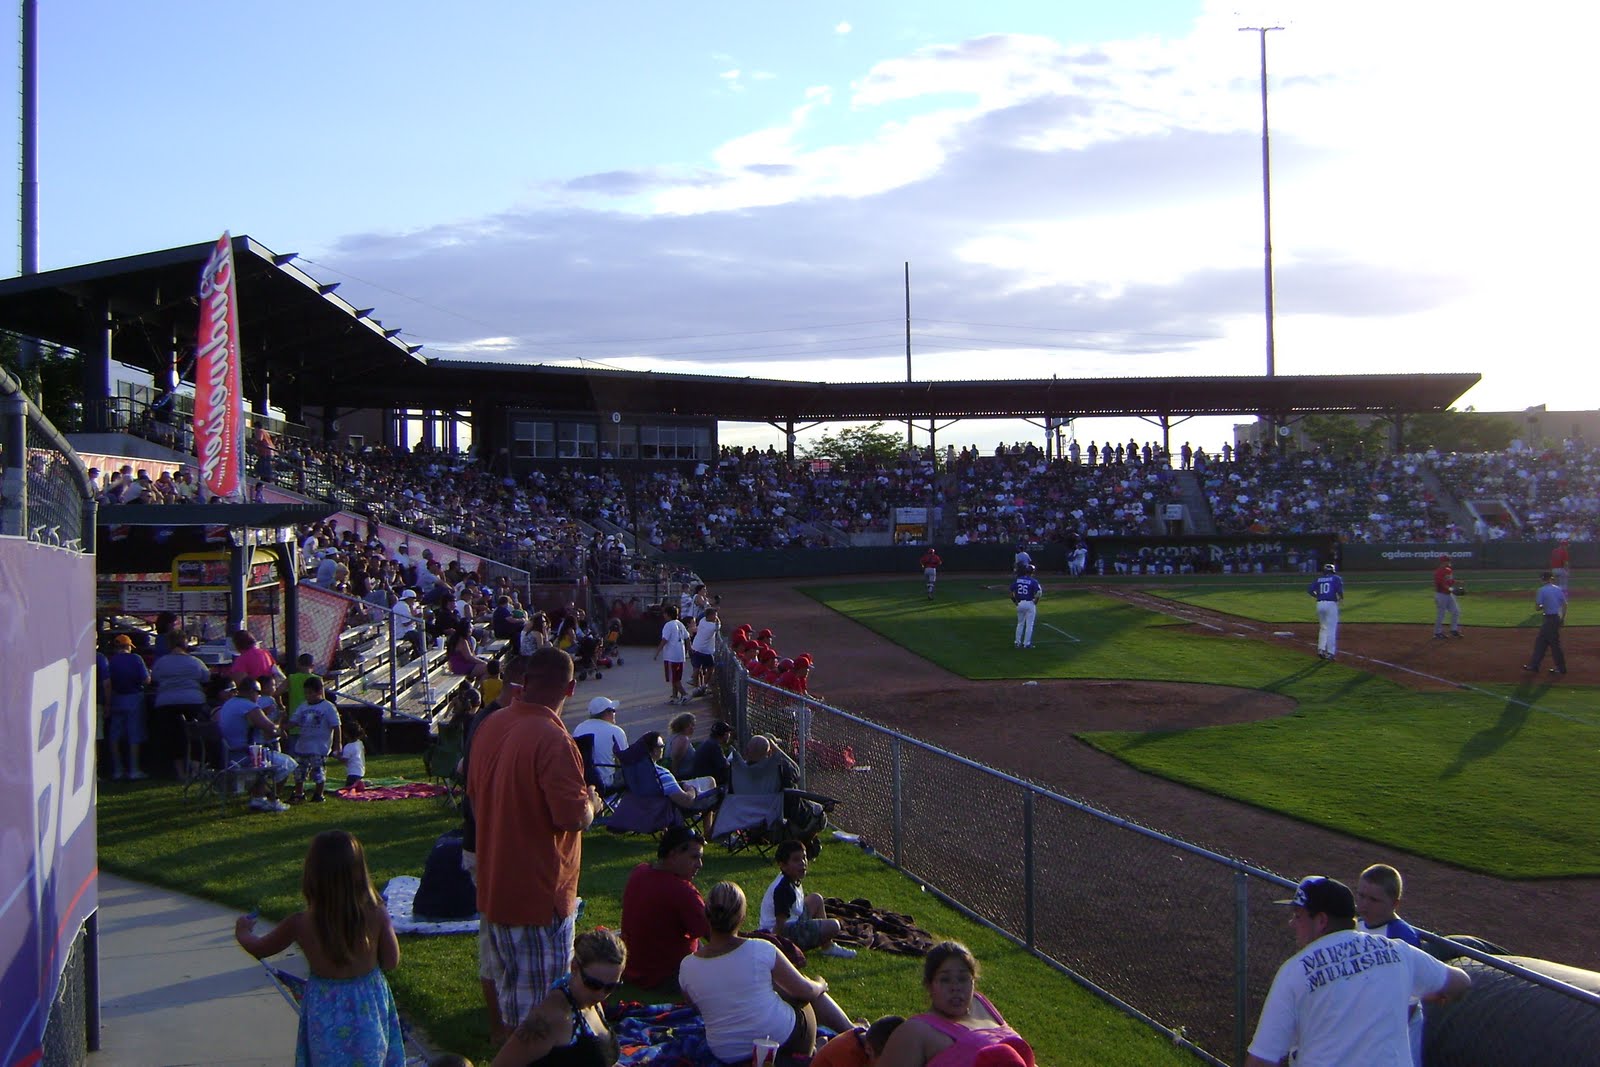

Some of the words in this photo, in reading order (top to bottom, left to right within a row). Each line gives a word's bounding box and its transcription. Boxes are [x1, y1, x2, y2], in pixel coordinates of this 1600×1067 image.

[1381, 549, 1473, 560] ogden-raptors.com
[1017, 583, 1029, 595] 26
[1319, 582, 1331, 595] 10
[31, 658, 97, 912] BU
